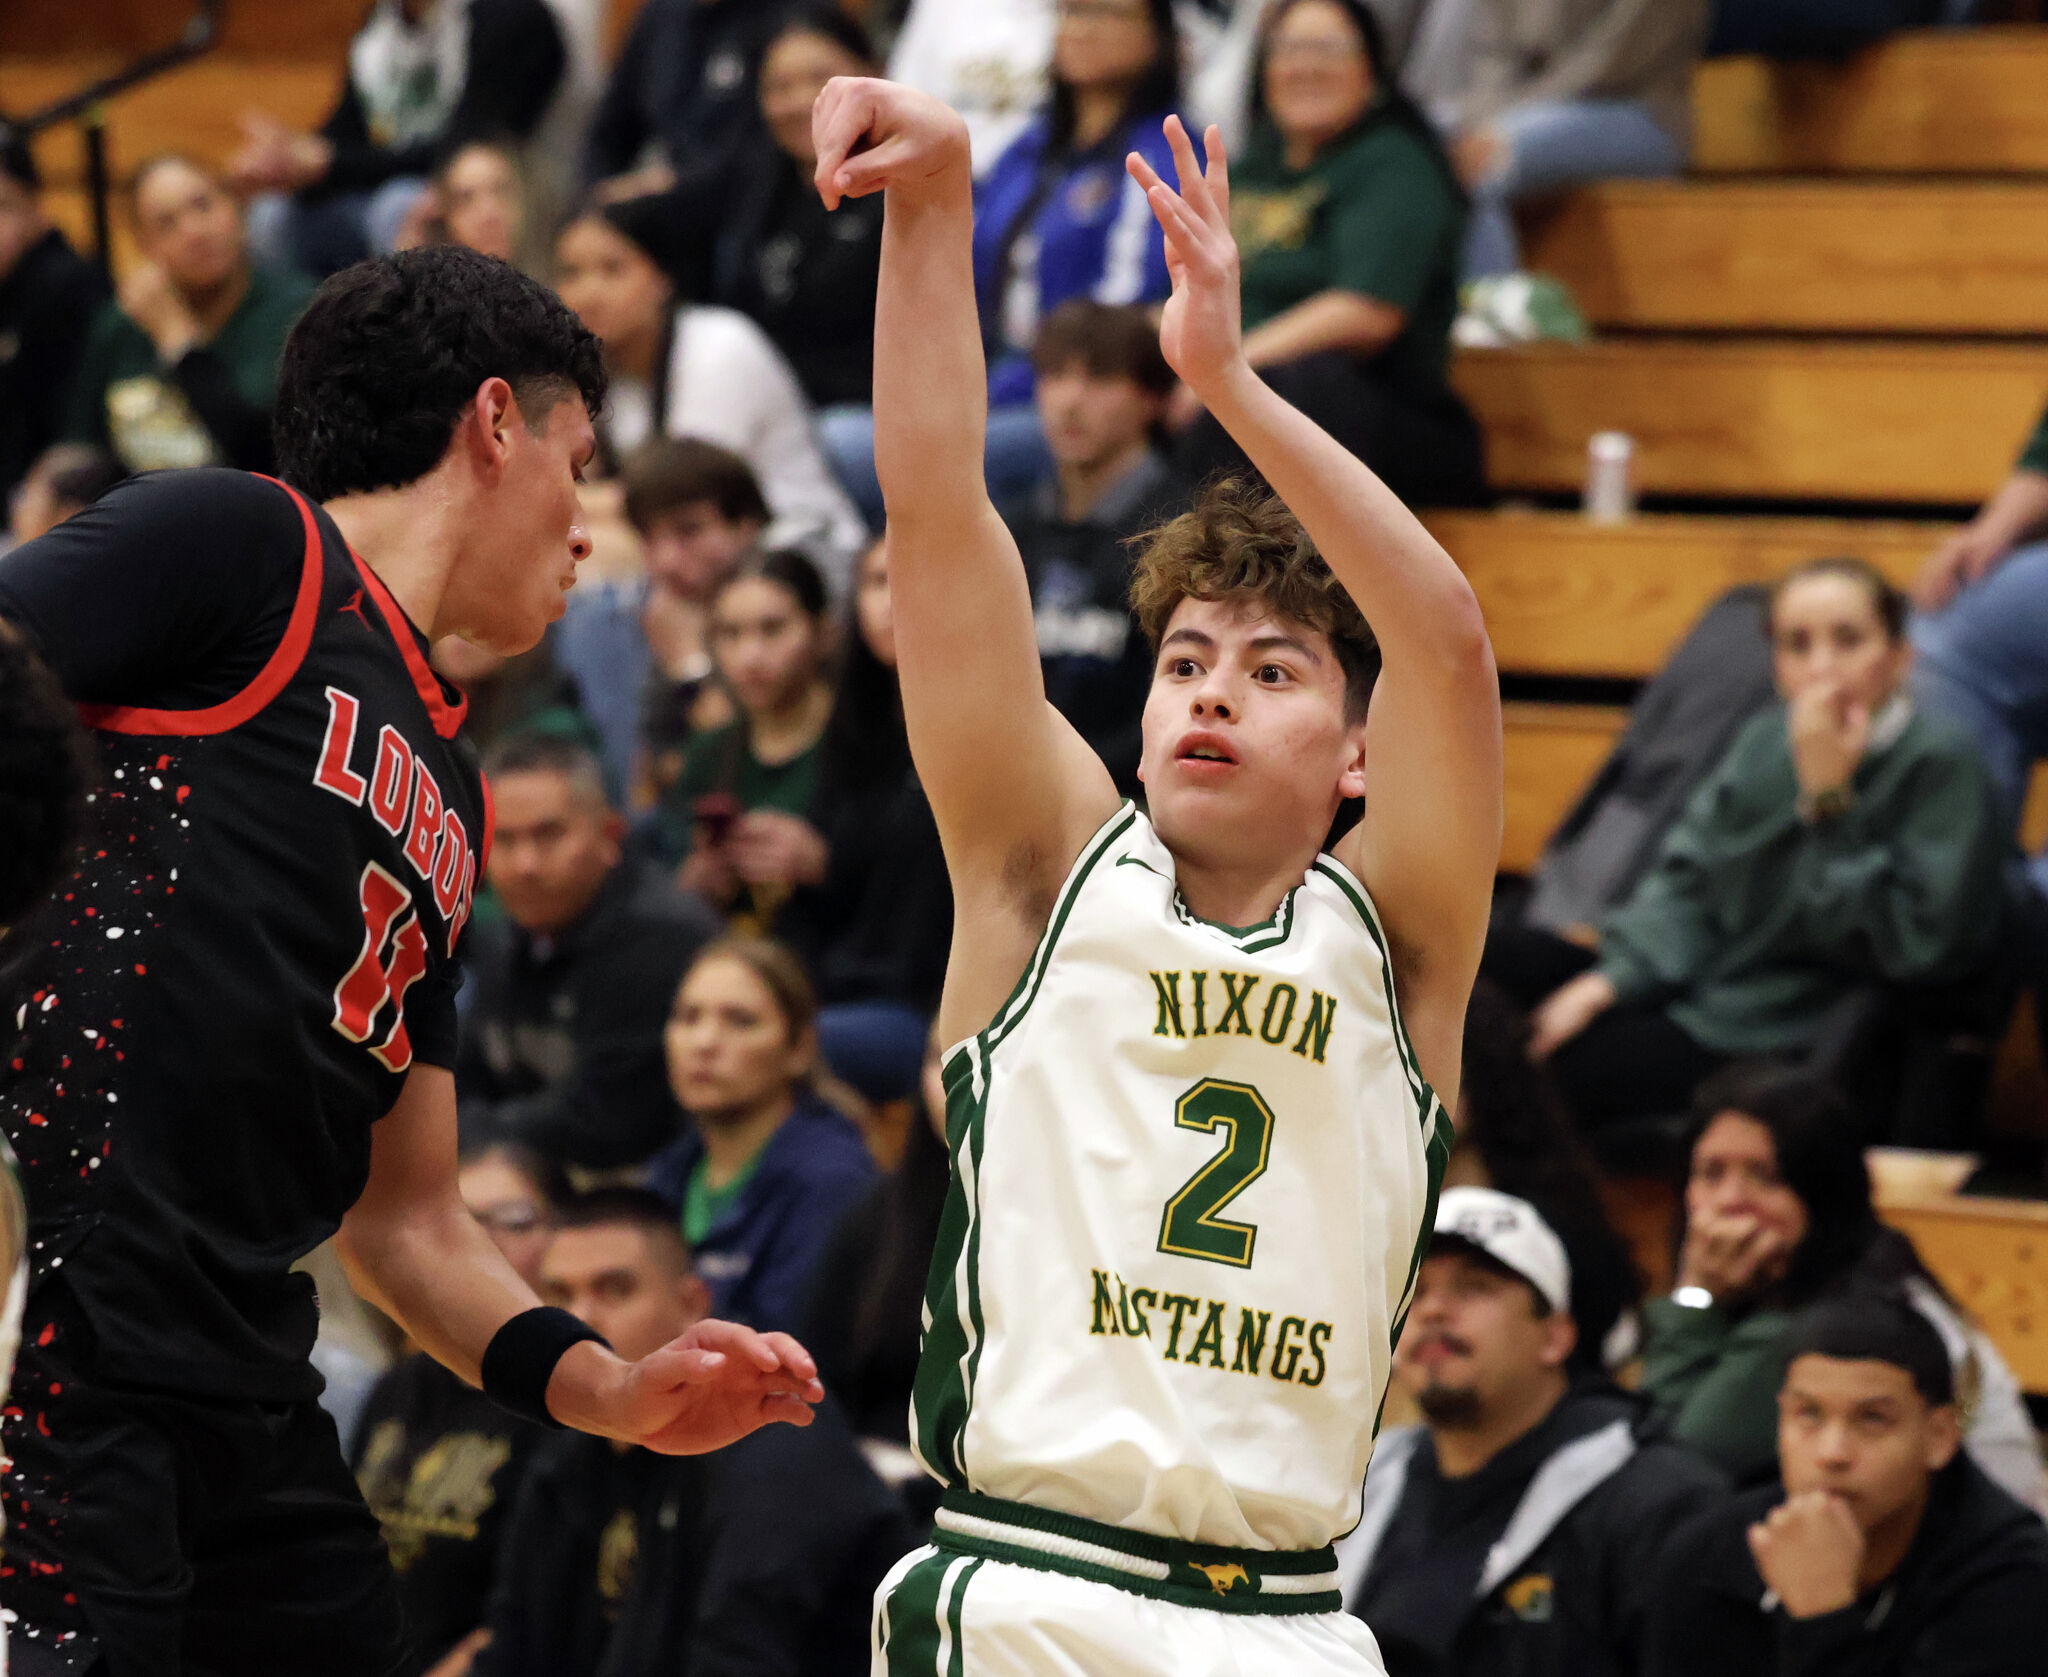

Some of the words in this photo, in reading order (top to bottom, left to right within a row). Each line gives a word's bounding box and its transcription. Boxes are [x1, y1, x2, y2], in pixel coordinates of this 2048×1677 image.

[331, 860, 429, 1073] 11
[1148, 969, 1338, 1065] NIXON
[1156, 1077, 1276, 1270] 2
